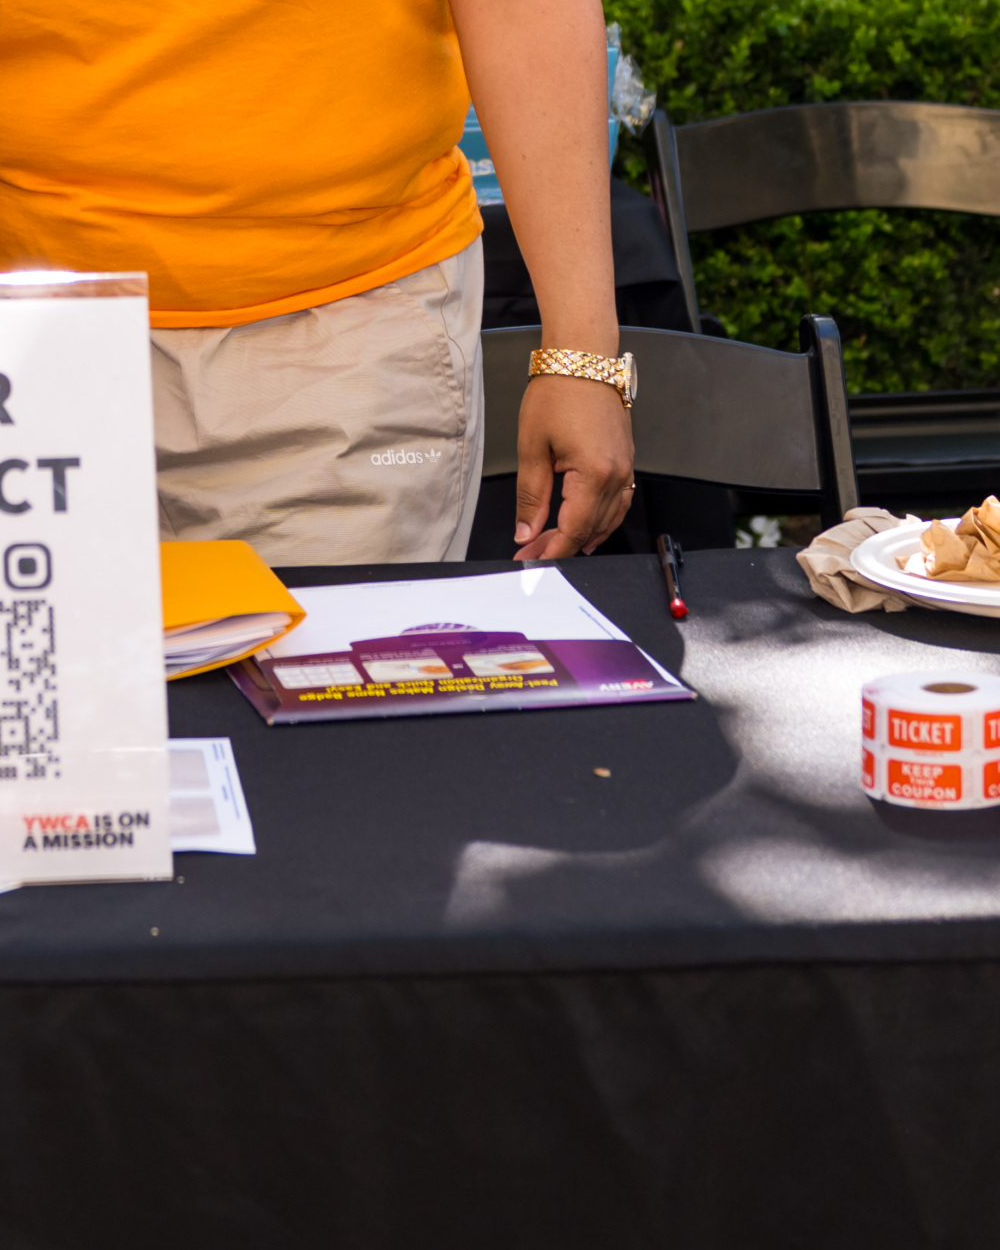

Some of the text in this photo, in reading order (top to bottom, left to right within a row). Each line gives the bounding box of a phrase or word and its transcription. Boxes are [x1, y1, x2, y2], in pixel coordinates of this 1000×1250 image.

[370, 449, 423, 465] adidas
[599, 680, 654, 691] AVERY
[891, 717, 955, 745] TICKET
[901, 762, 943, 777] KEEP
[891, 782, 957, 800] COUPON
[23, 812, 149, 831] YWCA IS ON
[23, 832, 133, 849] A MISSION
